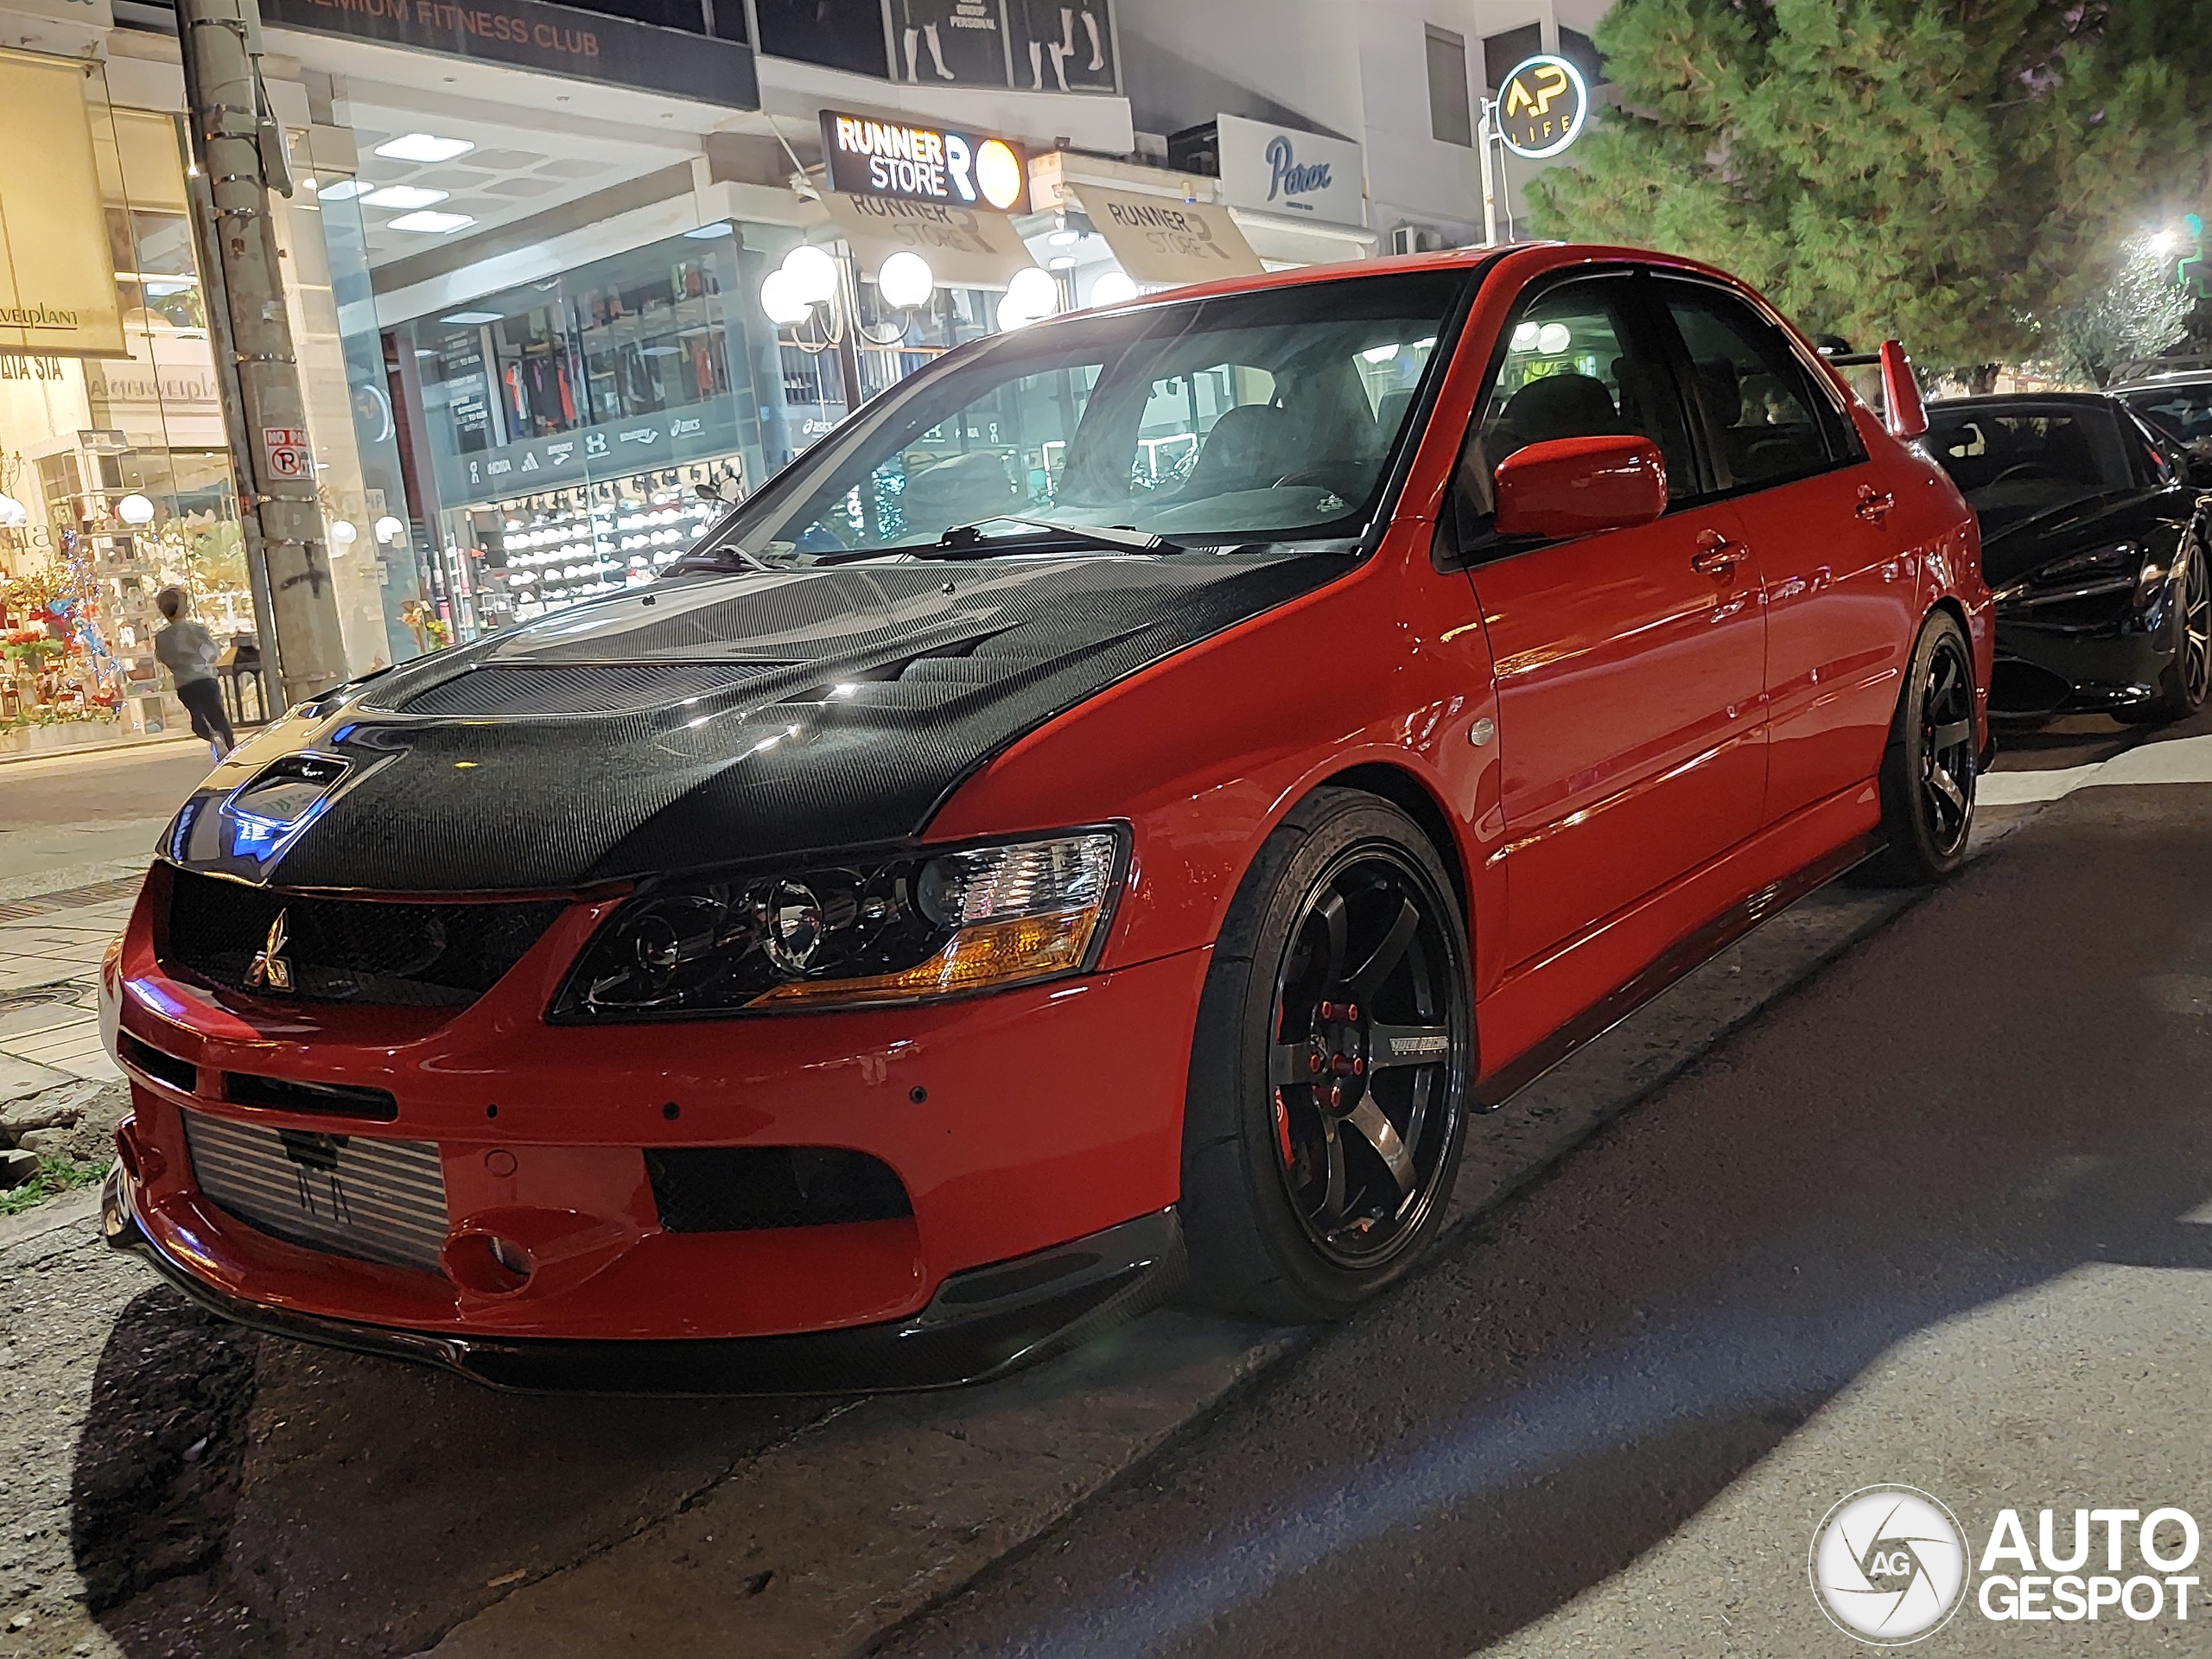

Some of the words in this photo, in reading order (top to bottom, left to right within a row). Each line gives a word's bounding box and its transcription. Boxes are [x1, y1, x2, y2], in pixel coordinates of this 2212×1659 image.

[416, 0, 529, 44] FITNESS
[533, 23, 599, 57] CLUB
[836, 116, 944, 165] RUNNER
[1511, 114, 1571, 147] LIFE
[869, 154, 949, 198] STORE
[849, 194, 952, 225] RUNNER
[1106, 202, 1192, 233] RUNNER
[893, 222, 973, 253] STORE
[1145, 231, 1209, 259] STORE
[267, 430, 286, 444] NO
